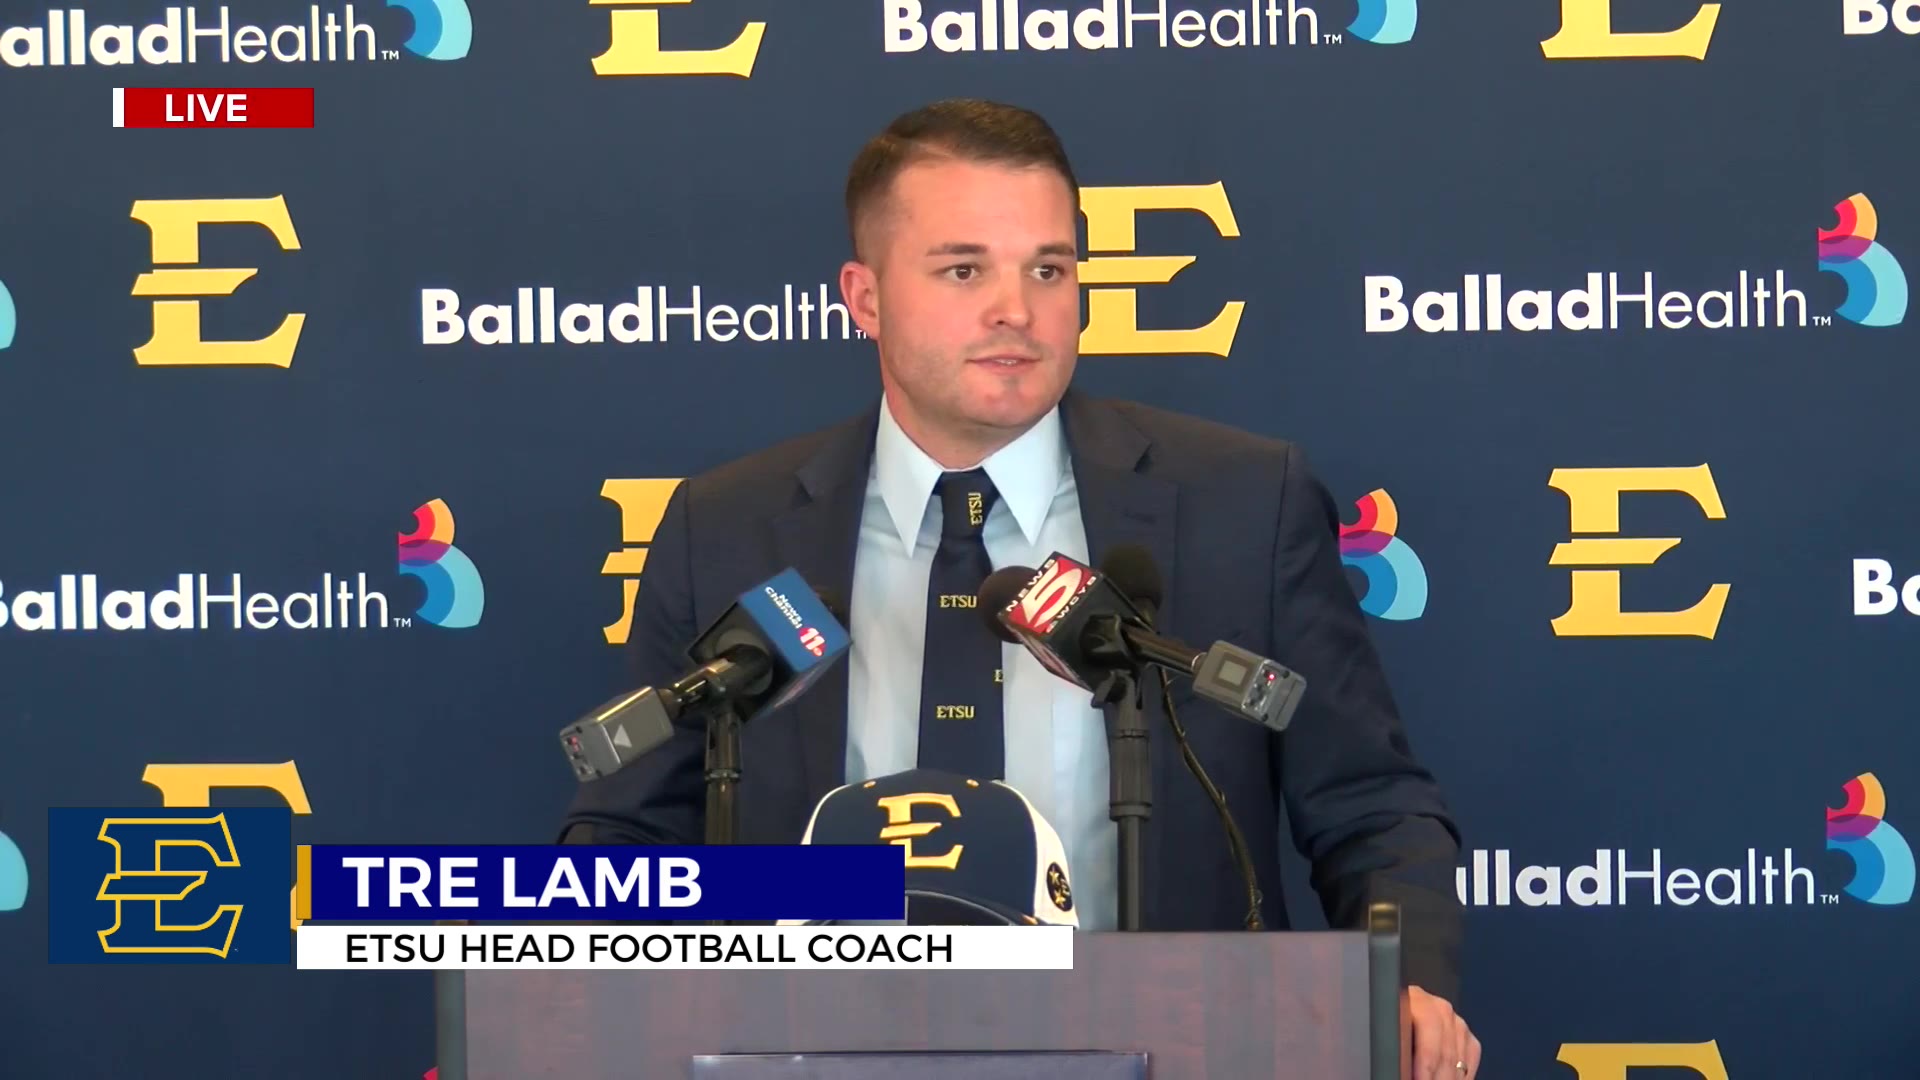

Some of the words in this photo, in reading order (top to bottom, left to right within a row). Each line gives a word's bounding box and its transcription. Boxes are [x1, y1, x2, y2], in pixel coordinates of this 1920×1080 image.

[884, 0, 1317, 52] BalladHealth
[422, 284, 850, 345] BalladHealth
[1364, 269, 1807, 332] BalladHealth
[968, 492, 983, 525] ETSU
[0, 572, 388, 630] alladHealth
[940, 595, 977, 608] ETSU
[1006, 559, 1055, 612] NEWS
[1021, 561, 1082, 628] 5
[936, 705, 974, 719] ETSU
[1456, 848, 1815, 907] lladHealth
